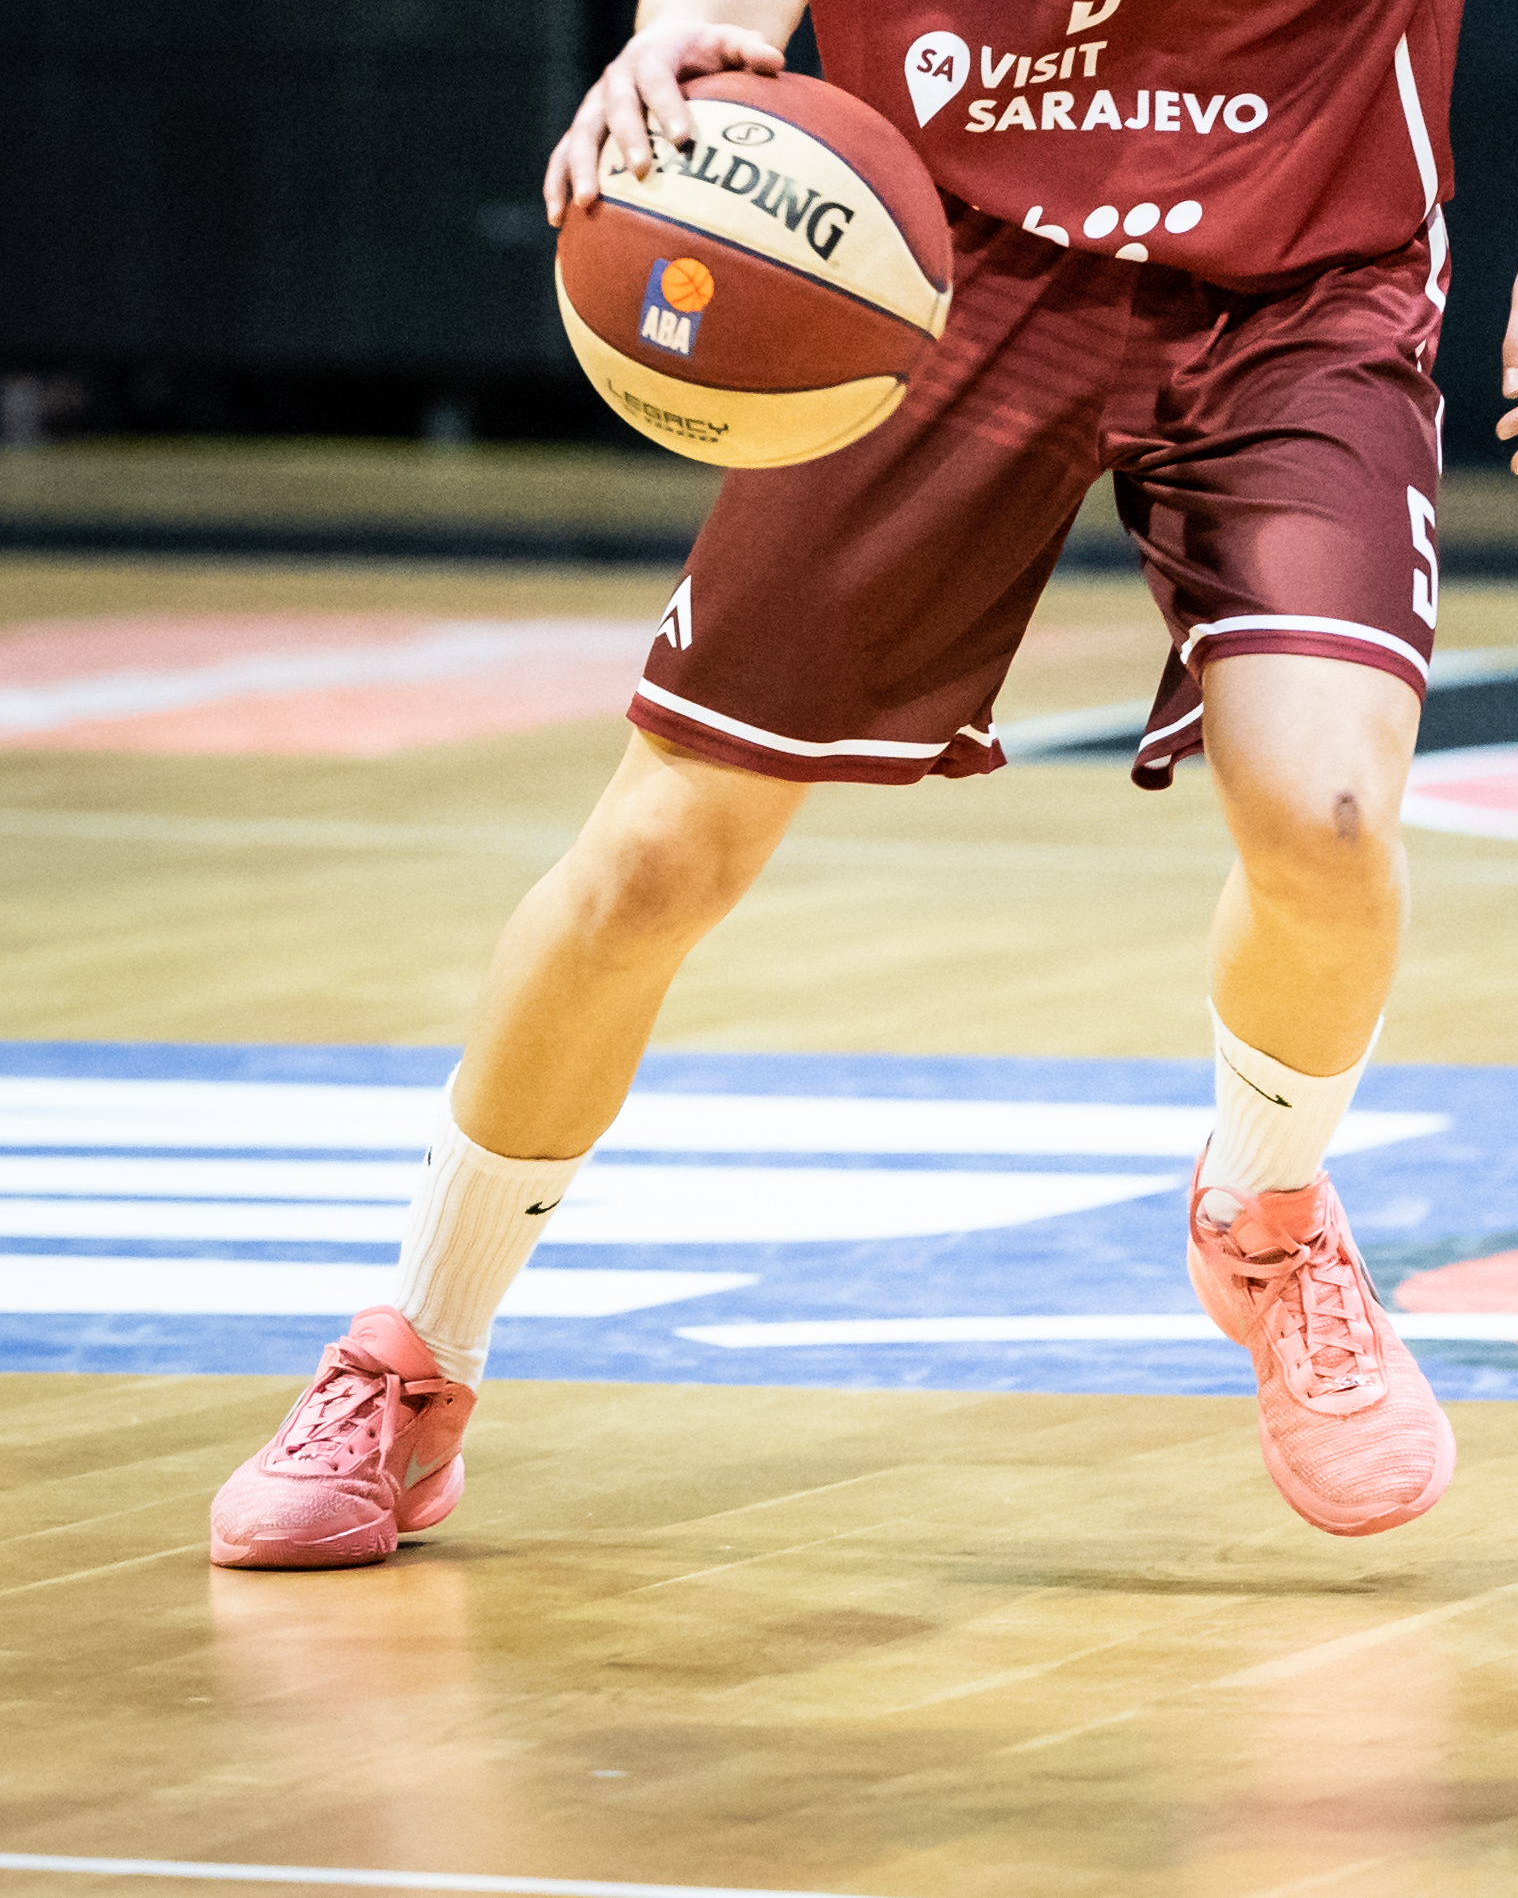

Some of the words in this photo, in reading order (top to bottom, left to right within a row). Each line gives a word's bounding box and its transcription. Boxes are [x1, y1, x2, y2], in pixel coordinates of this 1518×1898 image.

[916, 48, 955, 82] SA
[980, 40, 1108, 89] VISIT
[964, 89, 1269, 134] SARAJEVO
[608, 130, 855, 261] ALDING
[641, 304, 692, 356] ABA
[1406, 484, 1439, 630] 5
